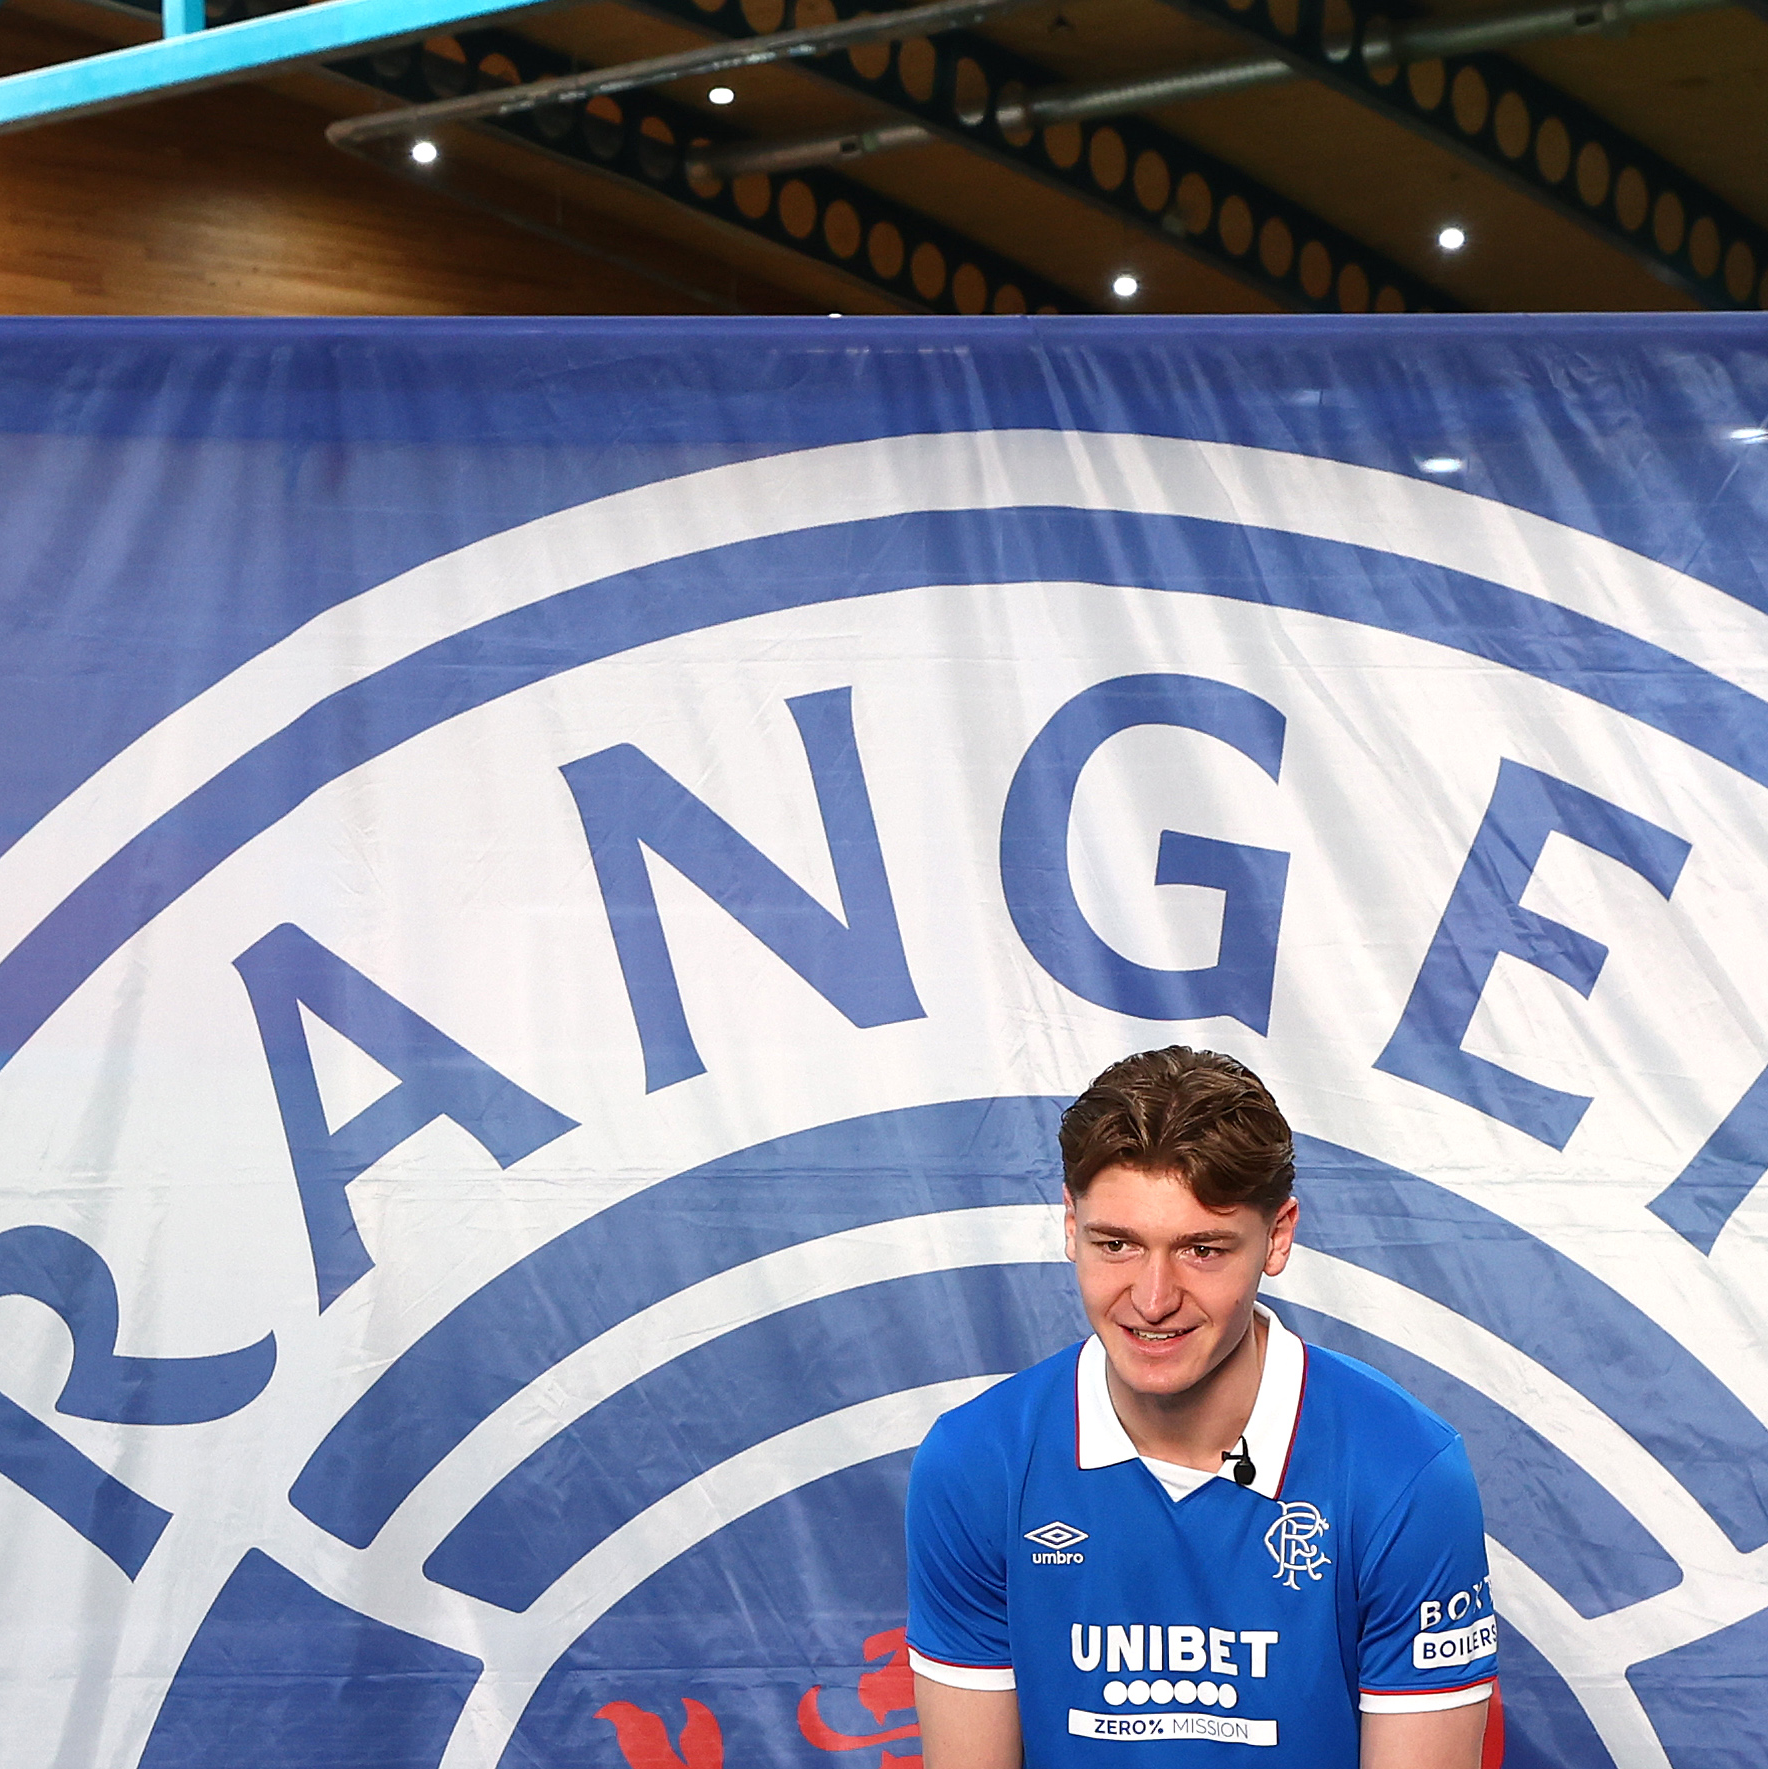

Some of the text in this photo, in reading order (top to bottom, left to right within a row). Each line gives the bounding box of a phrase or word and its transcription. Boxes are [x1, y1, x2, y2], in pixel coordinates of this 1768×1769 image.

[1032, 1550, 1084, 1565] umbro
[1071, 1622, 1279, 1678] UNIBET
[1094, 1718, 1249, 1739] ZERO% MISSION
